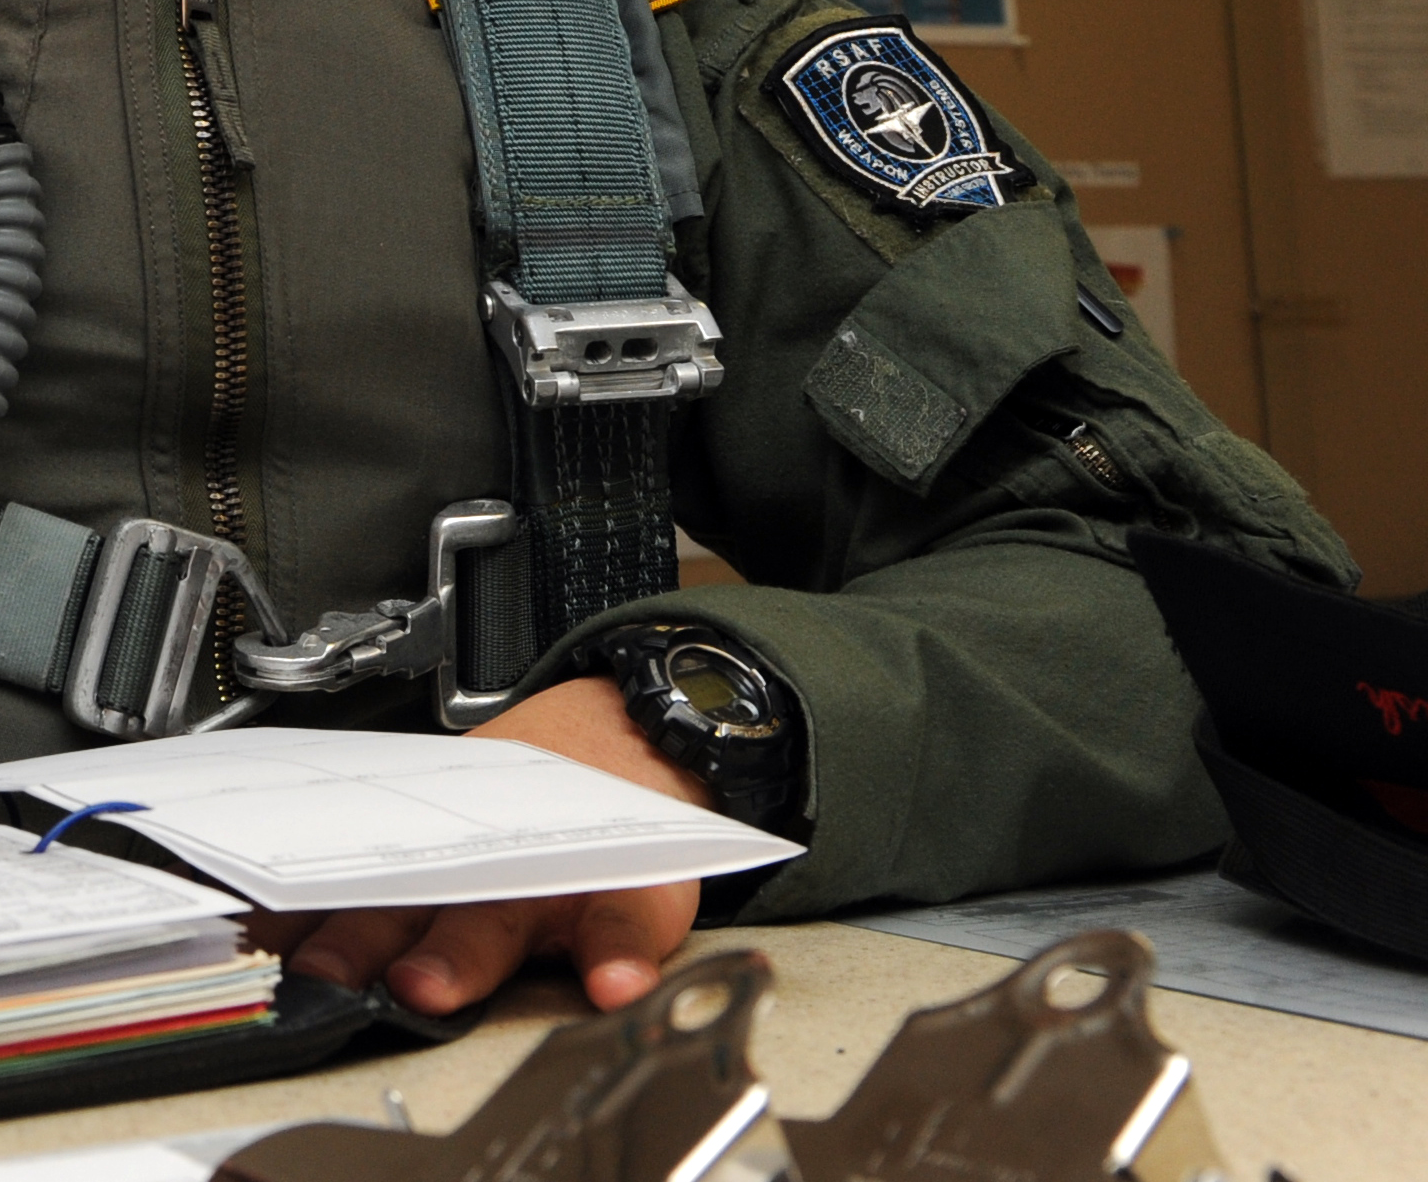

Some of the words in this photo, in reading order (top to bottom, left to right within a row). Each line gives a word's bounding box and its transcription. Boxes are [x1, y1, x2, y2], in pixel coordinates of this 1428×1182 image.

[815, 38, 883, 80] RSAF
[836, 128, 909, 183] WEAPON
[912, 157, 993, 199] INSTRUCTOR
